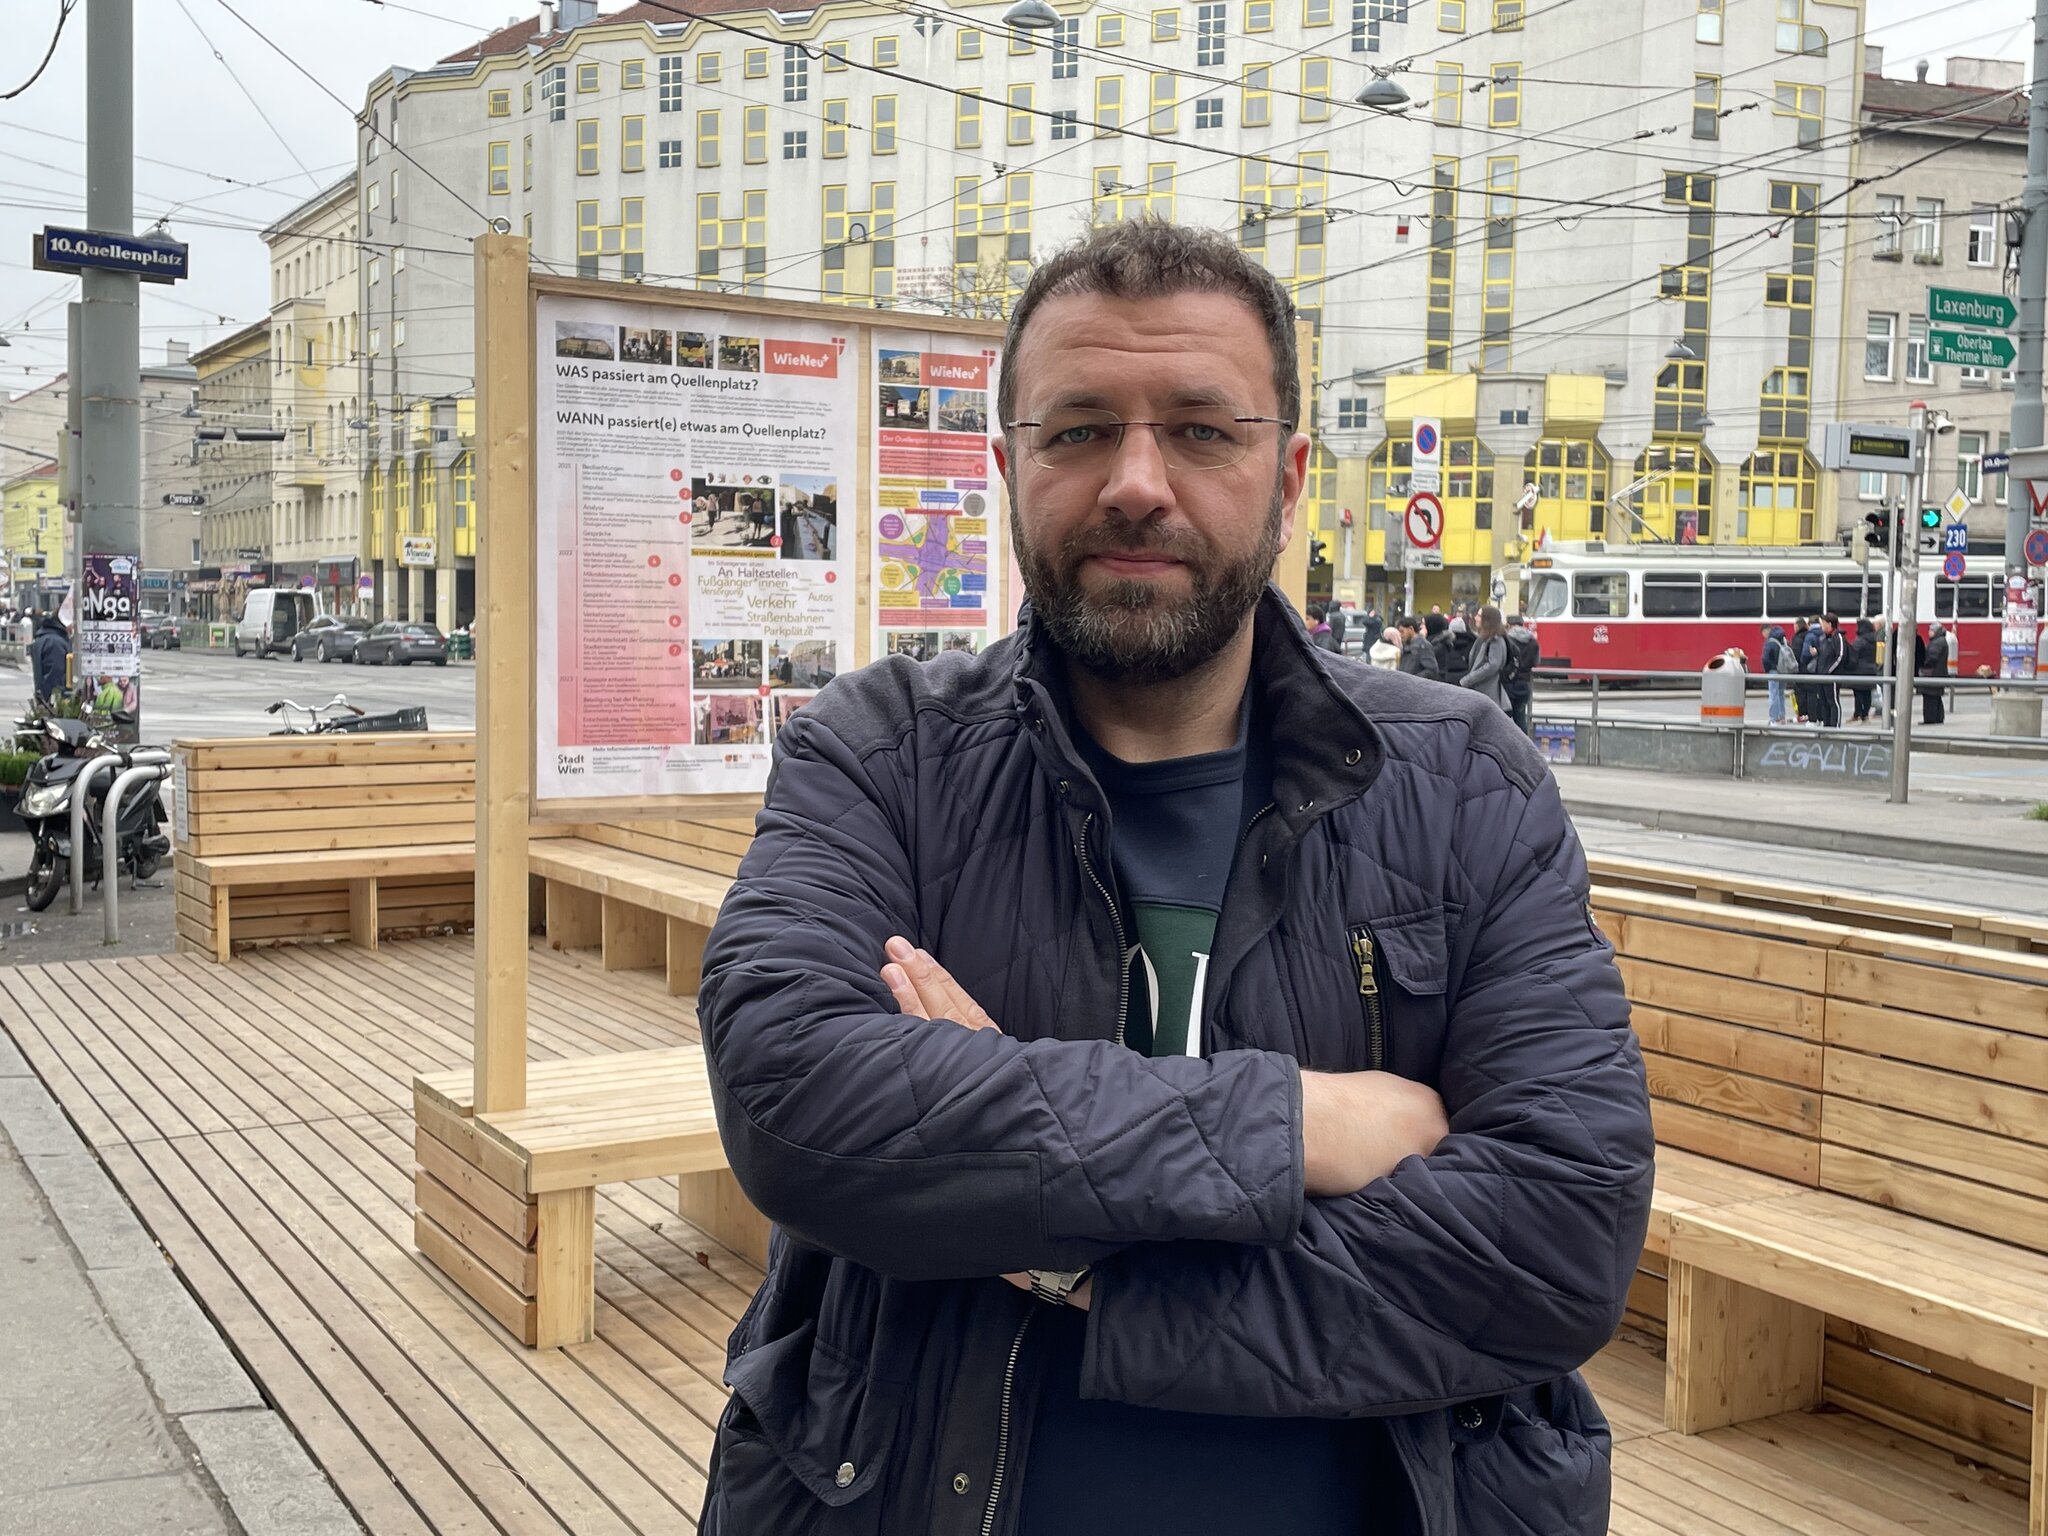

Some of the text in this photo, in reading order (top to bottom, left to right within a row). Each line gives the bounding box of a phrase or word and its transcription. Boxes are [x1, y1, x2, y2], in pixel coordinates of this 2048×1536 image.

[1936, 294, 2004, 326] Laxenburg
[1957, 334, 1992, 350] Oberlaa
[1945, 347, 2004, 366] Therme Wien
[556, 364, 758, 392] WAS passiert am Quellenplatz?
[556, 411, 826, 440] WANN passiert(e) etwas am Quellenplatz?
[1946, 530, 1966, 547] 230
[718, 567, 798, 579] An Haltestellen
[701, 587, 744, 598] Versorgung
[808, 592, 833, 602] Autos
[747, 596, 797, 609] Verkehr
[747, 612, 824, 623] Straßenbahnen
[764, 626, 814, 638] Parkplätze
[558, 754, 584, 764] Stadt
[558, 765, 584, 774] Wien
